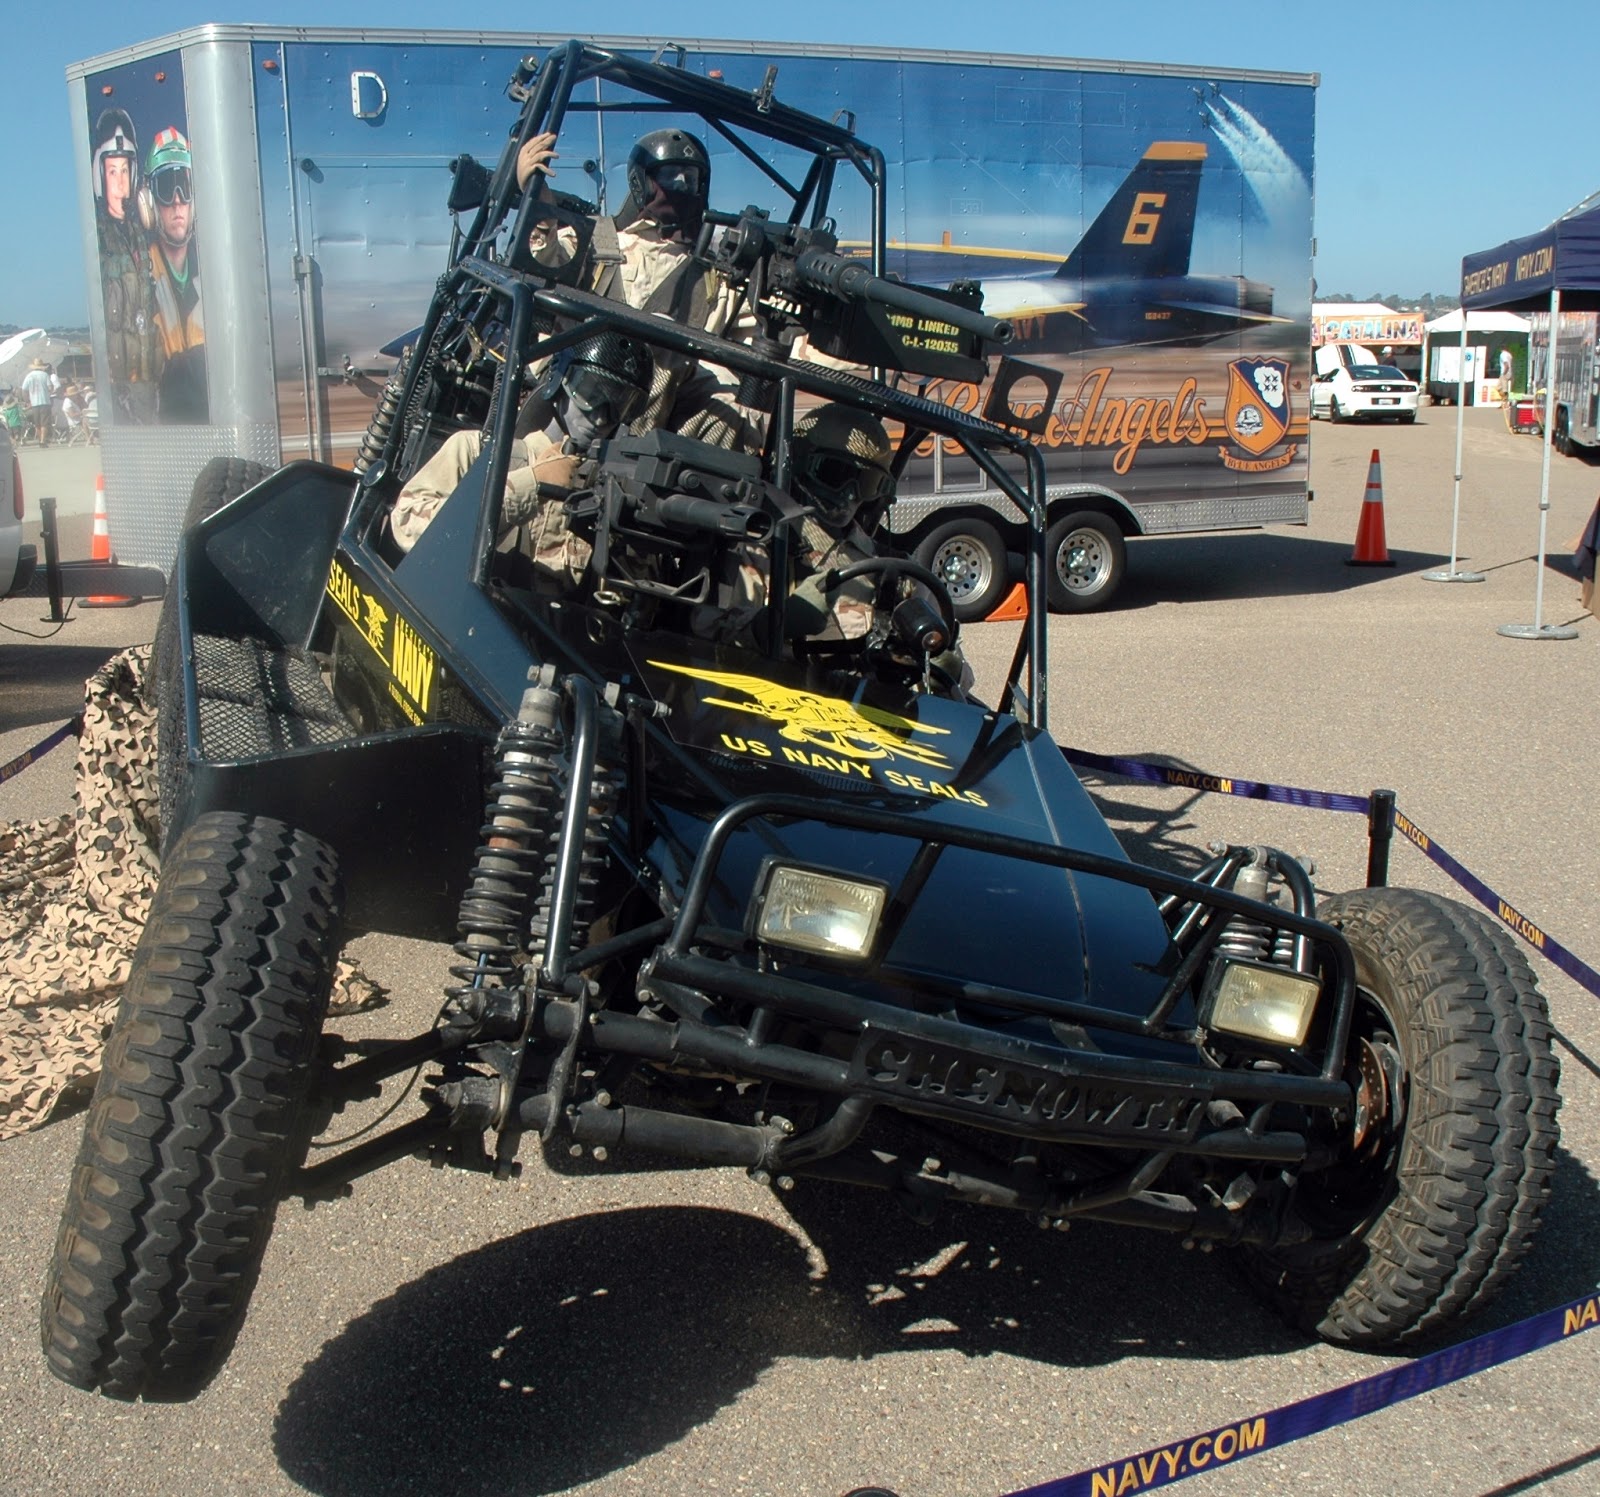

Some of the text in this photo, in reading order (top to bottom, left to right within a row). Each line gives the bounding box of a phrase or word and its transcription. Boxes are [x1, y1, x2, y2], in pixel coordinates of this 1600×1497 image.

[1121, 192, 1167, 245] 6
[1514, 245, 1553, 282] NAVY.COM
[917, 319, 960, 336] LINKED
[1325, 320, 1420, 341] CATALINA
[1046, 366, 1211, 475] Angels
[329, 558, 360, 621] SEALS
[392, 620, 434, 714] NAVY
[720, 733, 989, 807] US NAVY SEALS
[1167, 769, 1232, 793] NAVY.COM
[1394, 811, 1429, 851] NAVY.COM
[1499, 899, 1544, 949] NAVY.COM
[1091, 1417, 1266, 1497] NAVY.COM
